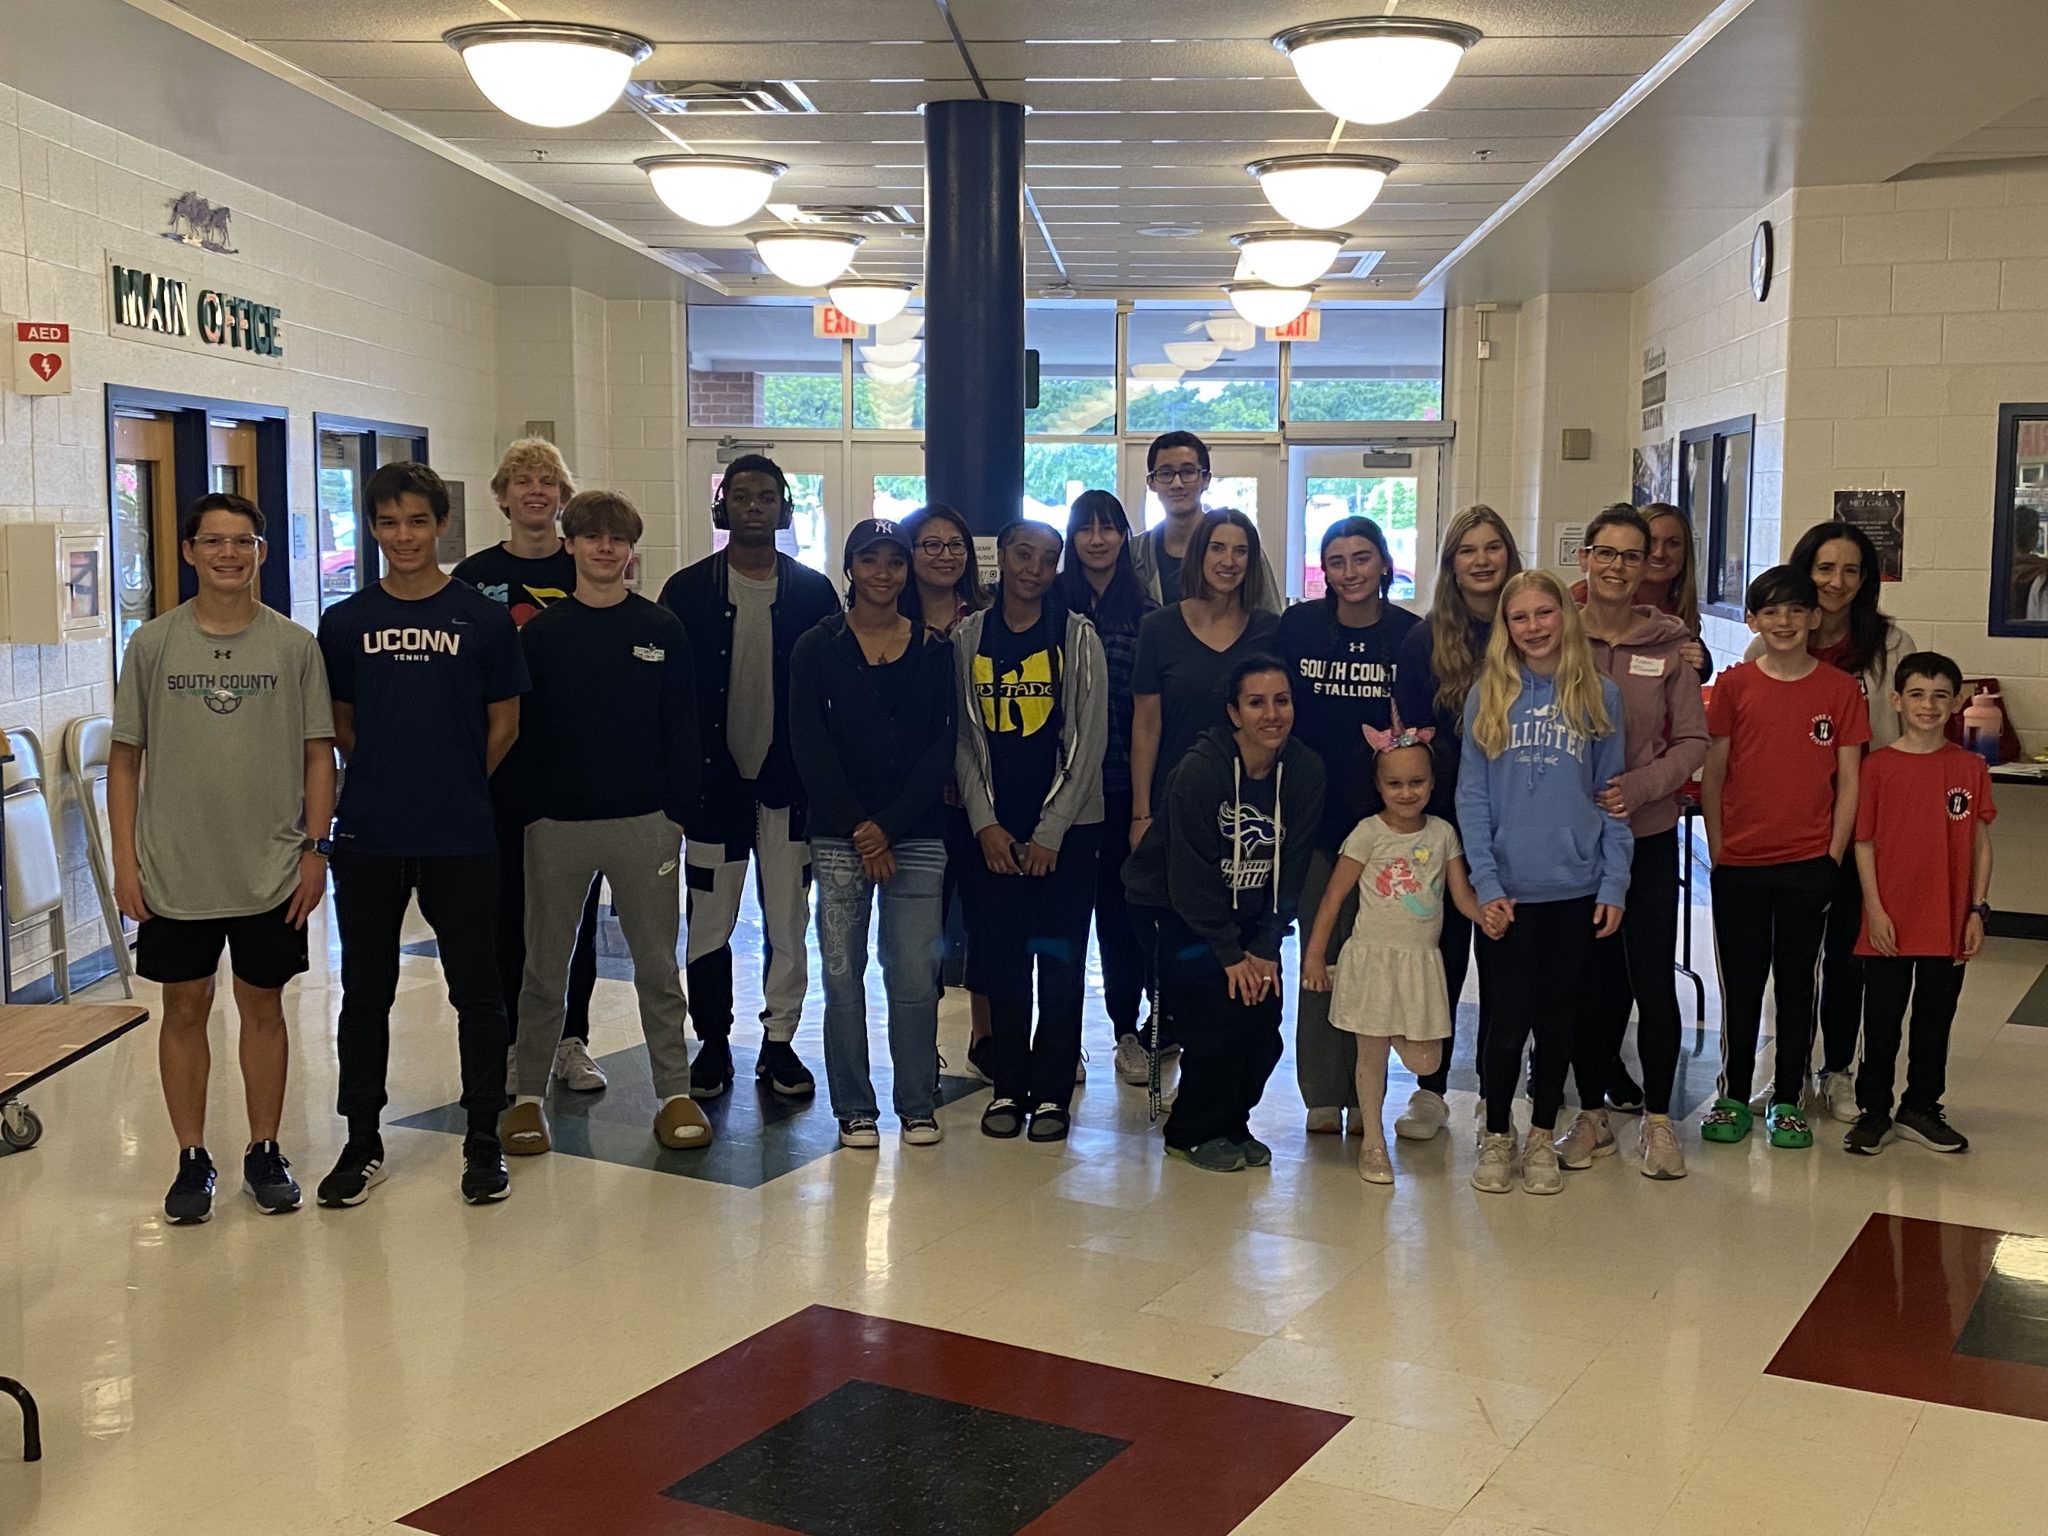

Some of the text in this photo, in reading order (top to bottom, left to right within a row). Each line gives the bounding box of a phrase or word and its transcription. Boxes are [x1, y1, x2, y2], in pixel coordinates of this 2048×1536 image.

[113, 265, 283, 357] MAIN OFFICE
[28, 326, 61, 340] AED
[875, 520, 893, 534] NY
[363, 628, 460, 656] UCONN
[393, 654, 430, 662] TENNIS
[1300, 658, 1398, 682] SOUTH COUNT
[167, 674, 278, 690] SOUTH COUNTY
